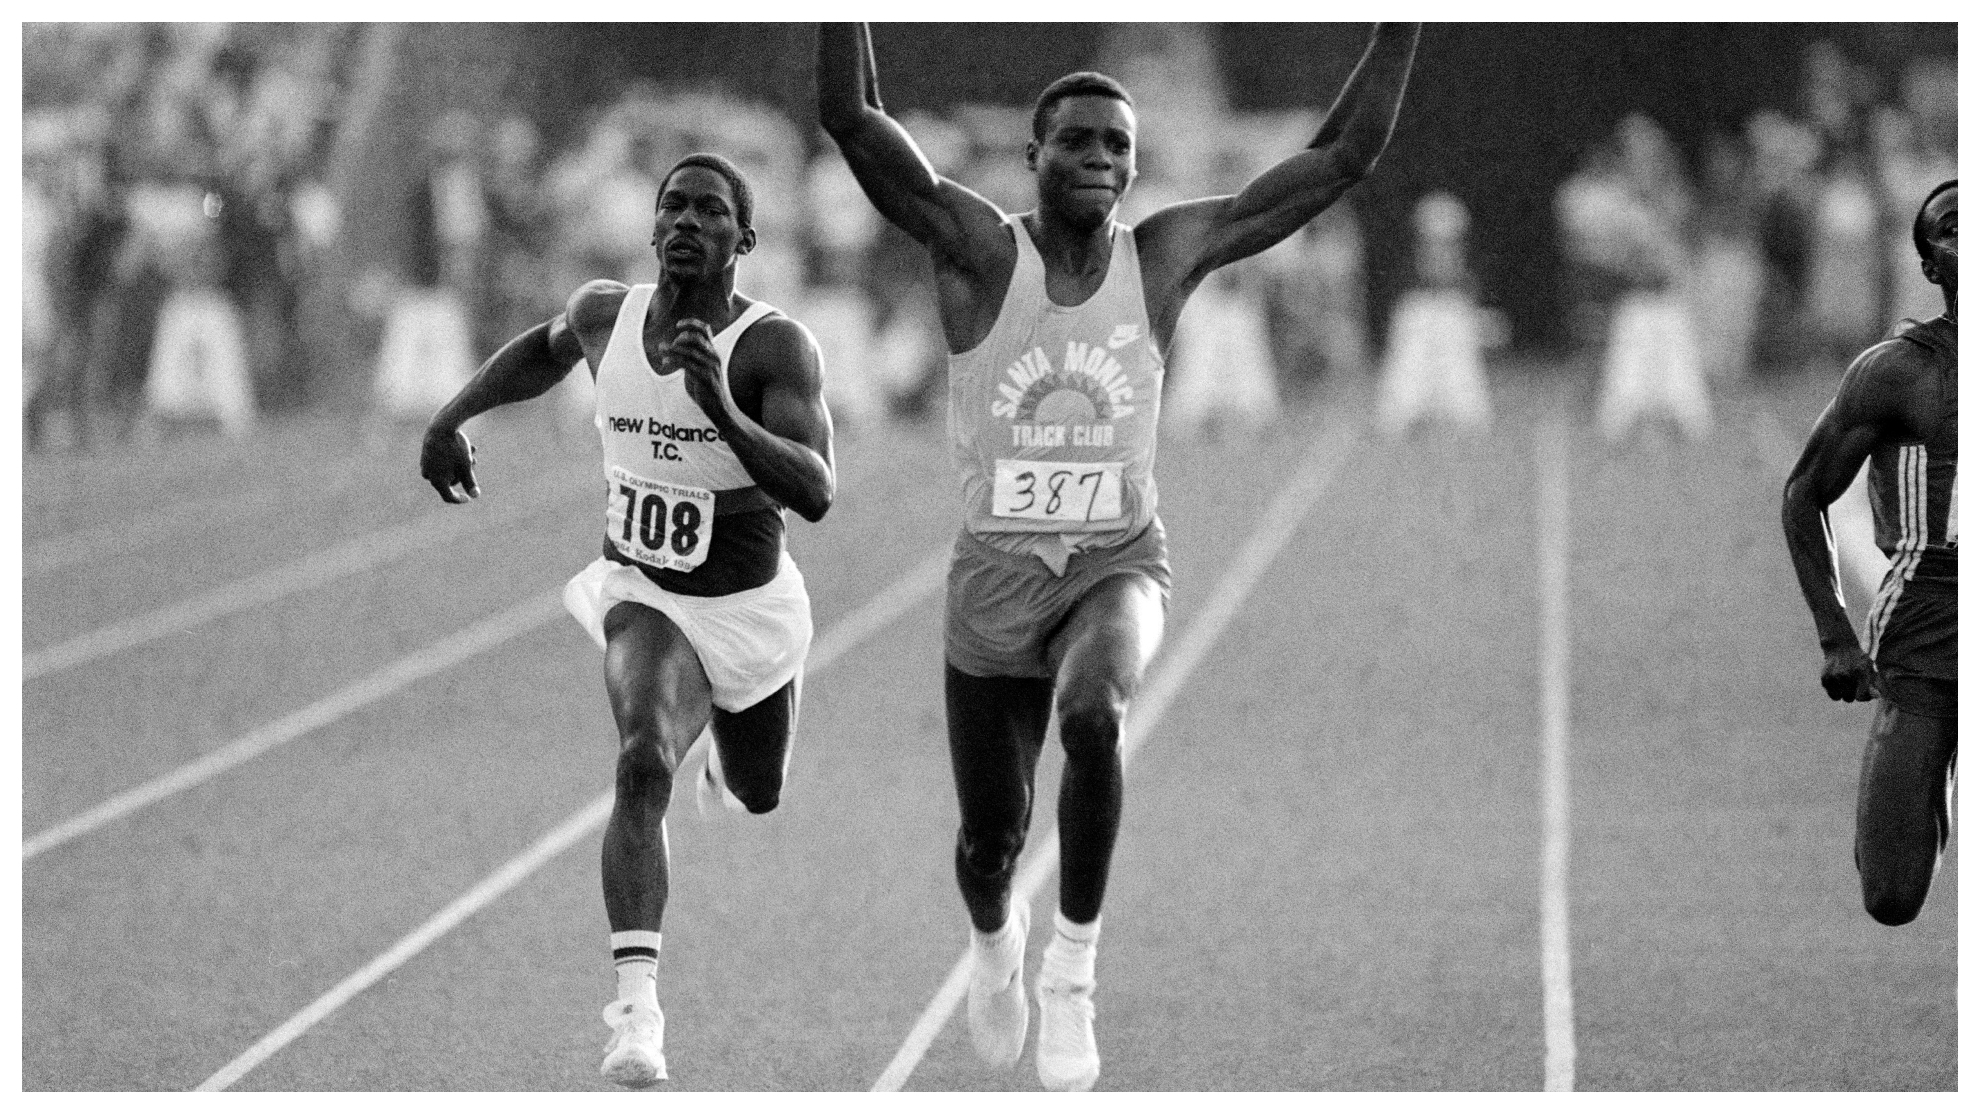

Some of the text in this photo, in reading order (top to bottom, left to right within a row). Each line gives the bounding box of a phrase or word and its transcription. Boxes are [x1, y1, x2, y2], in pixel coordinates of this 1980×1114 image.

[991, 340, 1136, 419] SANTA MONICA
[609, 416, 644, 433] new
[1012, 425, 1114, 446] TRACK CLUB
[651, 440, 682, 462] T.C.
[629, 477, 670, 495] OLYMPIC
[672, 487, 711, 501] TRIALS
[1009, 470, 1104, 523] 387
[619, 483, 702, 557] 708
